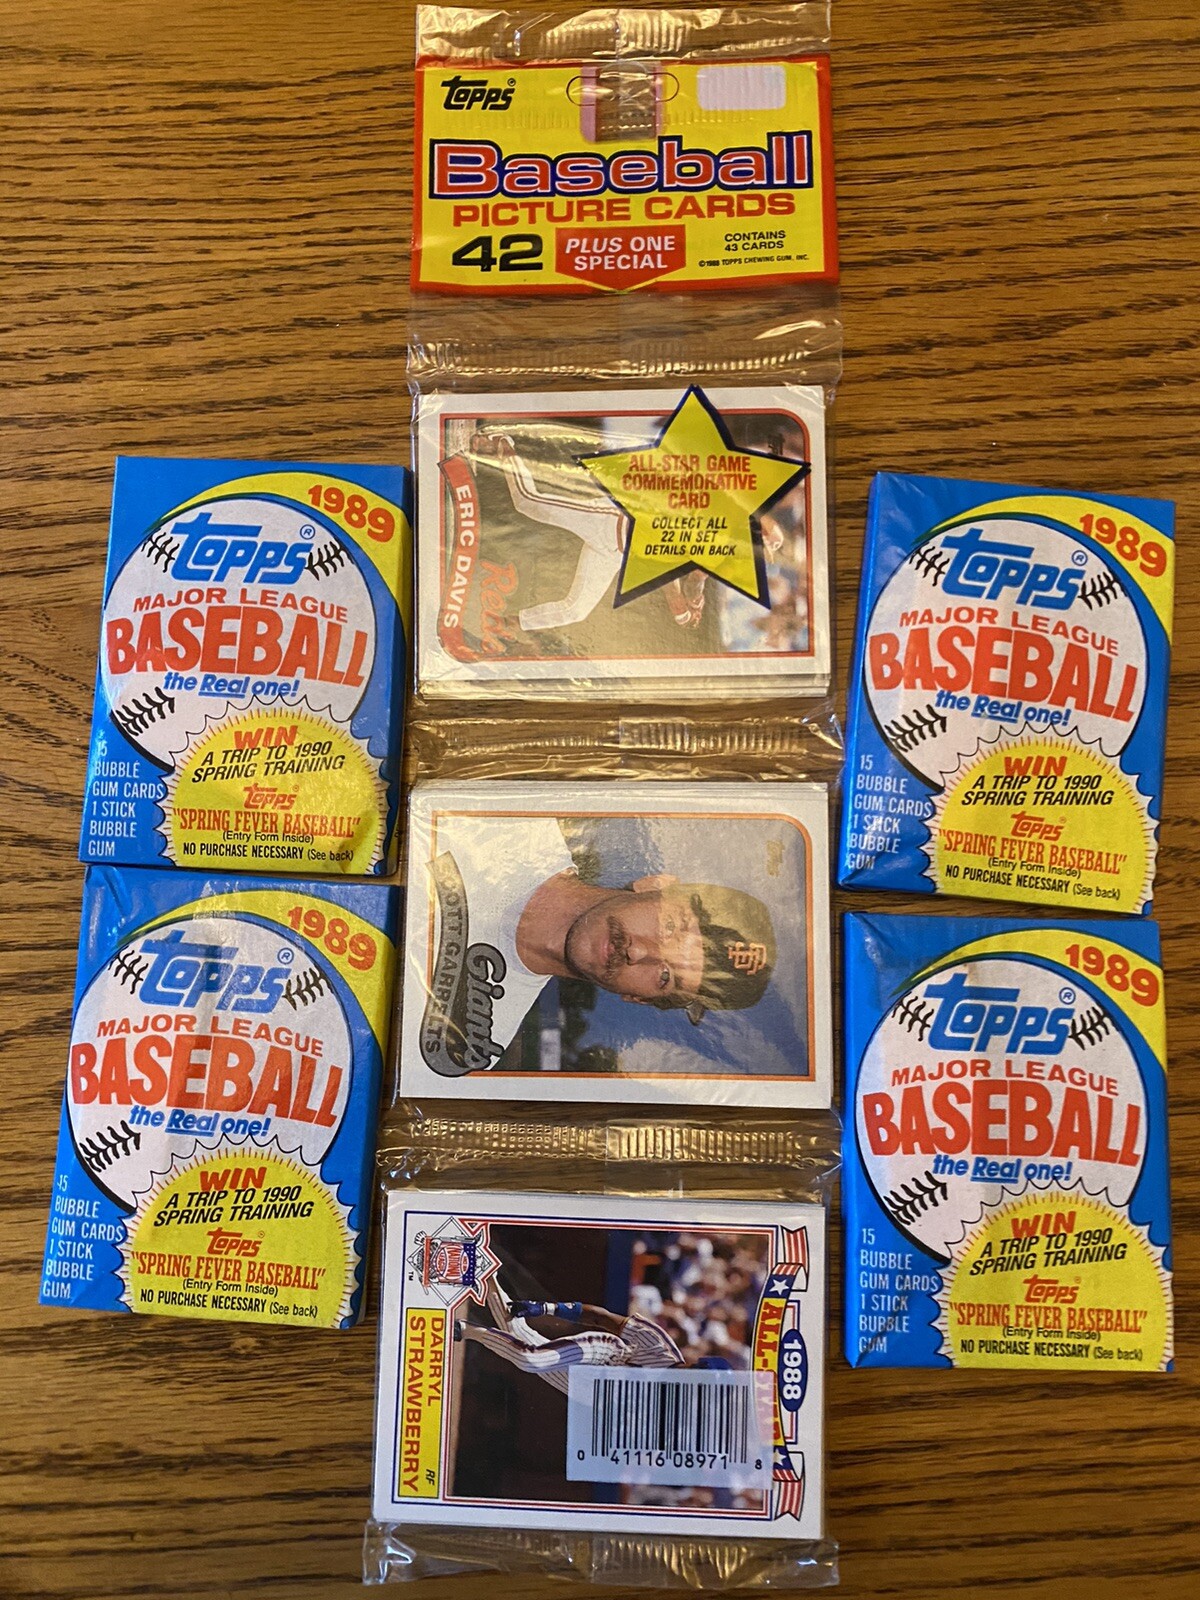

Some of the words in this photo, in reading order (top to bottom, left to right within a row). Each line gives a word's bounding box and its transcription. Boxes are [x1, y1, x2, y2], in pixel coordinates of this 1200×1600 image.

[429, 131, 813, 199] Baseball
[453, 199, 630, 228] PICTURE
[644, 193, 796, 221] CARDS
[565, 238, 623, 254] PLUS
[635, 236, 675, 252] ONE
[724, 230, 786, 242] CONTAINS
[742, 240, 784, 250] CARDS
[452, 234, 543, 272] 42
[574, 255, 668, 271] SPECIAL
[629, 455, 699, 472] ALL-STAR
[707, 456, 750, 471] GAME
[622, 474, 757, 491] COMMEMORATIVE
[668, 493, 710, 509] CARD
[308, 485, 395, 542] 1989
[455, 484, 476, 547] ERIC
[652, 517, 702, 529] COLLECT
[707, 517, 728, 529] ALL
[661, 531, 674, 542] 22
[679, 532, 691, 542] IN
[696, 531, 717, 542] SET
[1079, 513, 1167, 578] 1989
[645, 545, 685, 555] DETAILS
[689, 545, 704, 555] ON
[709, 545, 737, 556] BACK
[443, 555, 472, 628] DAVIS
[133, 588, 227, 613] MAJOR
[240, 588, 348, 623] LEAGUE
[480, 559, 518, 654] Reds
[900, 607, 999, 628] MAJOR
[1011, 611, 1119, 656] LEAGUE
[107, 605, 368, 686] BASEBALL
[164, 672, 197, 691] the
[198, 674, 249, 696] Real
[251, 679, 300, 696] one!
[869, 625, 1138, 723] BASEBALL
[935, 690, 971, 711] the
[972, 695, 1021, 723] Real
[1023, 708, 1071, 726] one!
[233, 725, 298, 750] WIN
[201, 752, 213, 765] A
[221, 748, 261, 763] TRIP
[267, 745, 287, 760] TO
[295, 741, 332, 756] 1990
[192, 763, 257, 783] SPRING
[264, 755, 345, 776] TRAINING
[1004, 756, 1067, 777] WIN
[973, 776, 984, 789] A
[992, 776, 1032, 789] TRIP
[1036, 776, 1057, 789] TO
[1064, 775, 1102, 789] 1990
[961, 791, 1026, 806] SPRING
[1032, 790, 1114, 806] TRAINING
[234, 812, 280, 833] FEVER
[183, 842, 196, 855] NO
[200, 844, 247, 858] PURCHASE
[251, 846, 304, 860] NECESSARY
[946, 865, 959, 879] NO
[963, 868, 1012, 886] PURCHASE
[1016, 874, 1070, 894] NECESSARY
[287, 906, 377, 970] 1989
[1065, 944, 1159, 1007] 1989
[463, 943, 507, 1069] Giants
[97, 1014, 197, 1038] MAJOR
[210, 1016, 323, 1057] LEAGUE
[71, 1034, 345, 1127] BASEBALL
[891, 1059, 991, 1086] MAJOR
[1005, 1060, 1119, 1096] LEAGUE
[129, 1105, 165, 1127] the
[165, 1110, 220, 1136] Real
[221, 1117, 271, 1136] one!
[863, 1079, 1141, 1167] BASEBALL
[200, 1167, 267, 1192] WIN
[933, 1156, 969, 1175] the
[971, 1157, 1021, 1183] Real
[1024, 1161, 1072, 1180] one!
[55, 1197, 101, 1219] BUBBLE
[166, 1193, 178, 1208] A
[187, 1191, 227, 1207] TRIP
[235, 1188, 254, 1204] TO
[262, 1186, 302, 1202] 1990
[154, 1207, 223, 1227] SPRING
[229, 1202, 314, 1222] TRAINING
[1011, 1211, 1076, 1239] WIN
[51, 1220, 76, 1237] GUM
[81, 1224, 124, 1242] CARDS
[981, 1242, 993, 1258] A
[1000, 1236, 1039, 1252] TRIP
[1046, 1233, 1068, 1248] TO
[1074, 1228, 1113, 1245] 1990
[58, 1241, 93, 1260] STICK
[861, 1250, 912, 1270] BUBBLE
[969, 1255, 1036, 1276] SPRING
[1043, 1243, 1127, 1266] TRAINING
[46, 1260, 95, 1281] BUBBLE
[195, 1258, 245, 1282] FEVER
[860, 1272, 889, 1289] GUM
[896, 1275, 938, 1292] CARDS
[43, 1282, 71, 1299] GUM
[216, 1280, 241, 1293] Form
[140, 1289, 154, 1302] NO
[158, 1291, 208, 1307] PURCHASE
[212, 1296, 267, 1313] NECESSARY
[871, 1294, 908, 1311] STICK
[859, 1315, 909, 1332] BUBBLE
[1015, 1306, 1060, 1329] FEVER
[859, 1337, 887, 1353] GUM
[961, 1339, 975, 1353] NO
[979, 1341, 1029, 1356] PURCHASE
[1034, 1343, 1090, 1358] NECESSARY
[427, 1317, 444, 1406] DARRYL
[782, 1339, 802, 1401] 1988
[402, 1316, 426, 1492] STRAWBERRY
[577, 1450, 585, 1461] 0
[611, 1450, 665, 1466] 41116
[673, 1452, 727, 1469] 08971
[755, 1460, 762, 1470] 8
[426, 1468, 435, 1486] RF
